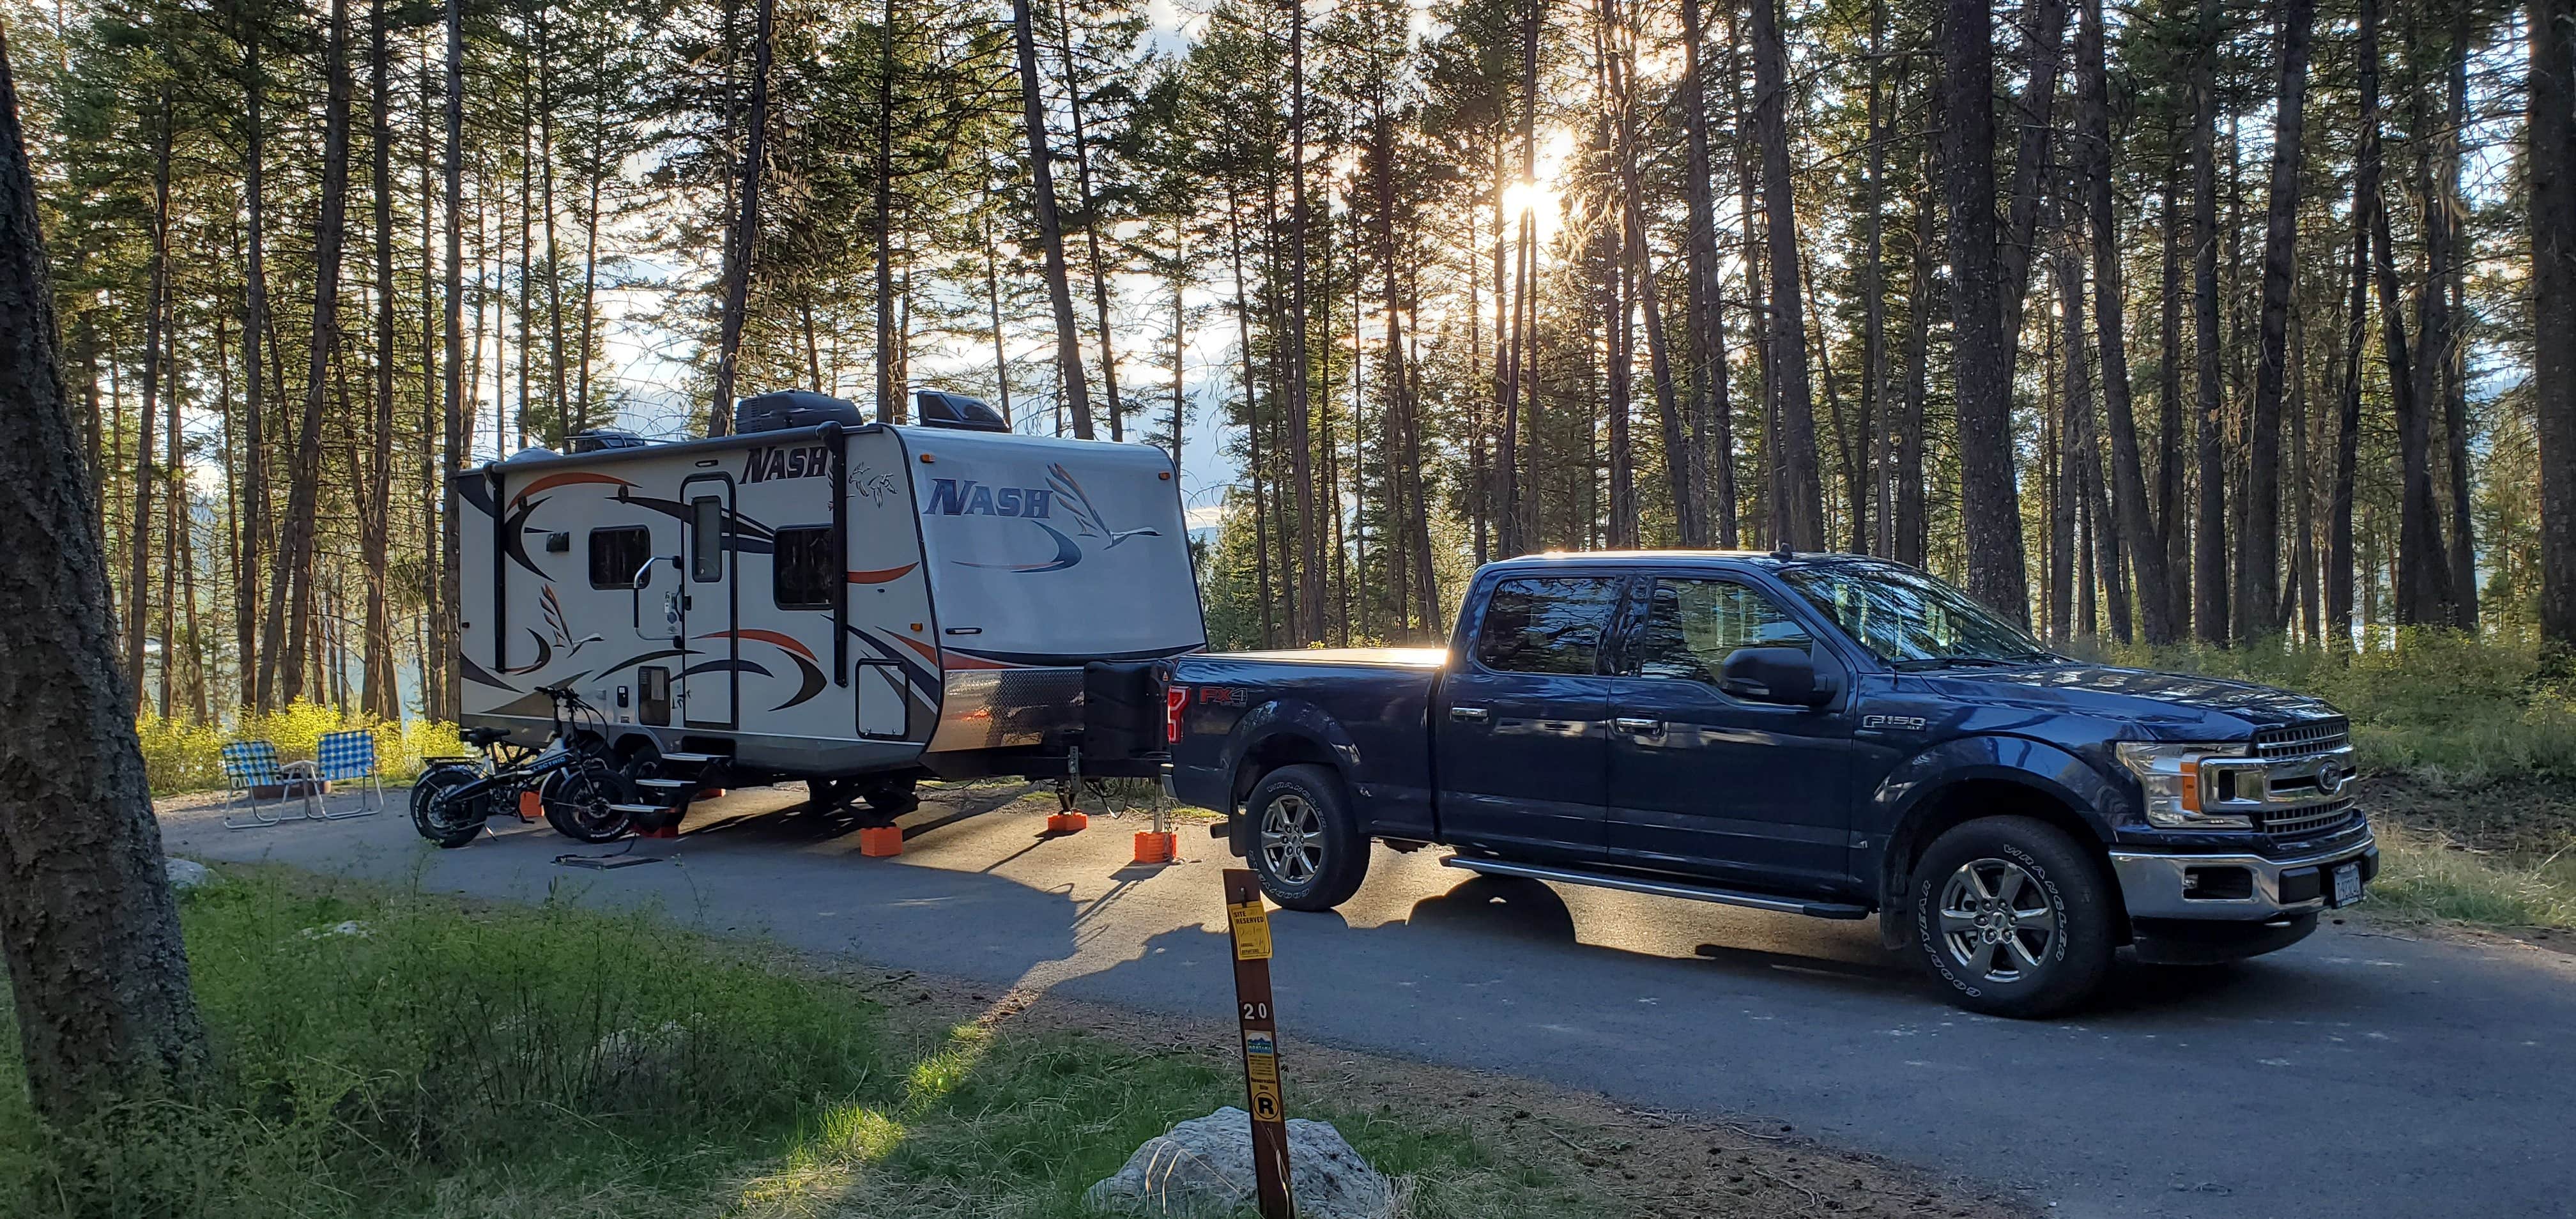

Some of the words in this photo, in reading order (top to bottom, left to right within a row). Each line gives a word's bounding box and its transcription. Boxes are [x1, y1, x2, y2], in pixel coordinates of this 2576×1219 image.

[738, 447, 829, 485] NASH
[923, 479, 1054, 519] NASH
[1199, 686, 1248, 704] FX4
[1862, 715, 1926, 728] F150
[2004, 844, 2067, 962] WRANGLER
[1236, 916, 1264, 924] RESERVED
[1919, 880, 1981, 997] GOODYEAR
[1243, 1002, 1268, 1020] 20
[1257, 1096, 1275, 1115] R
